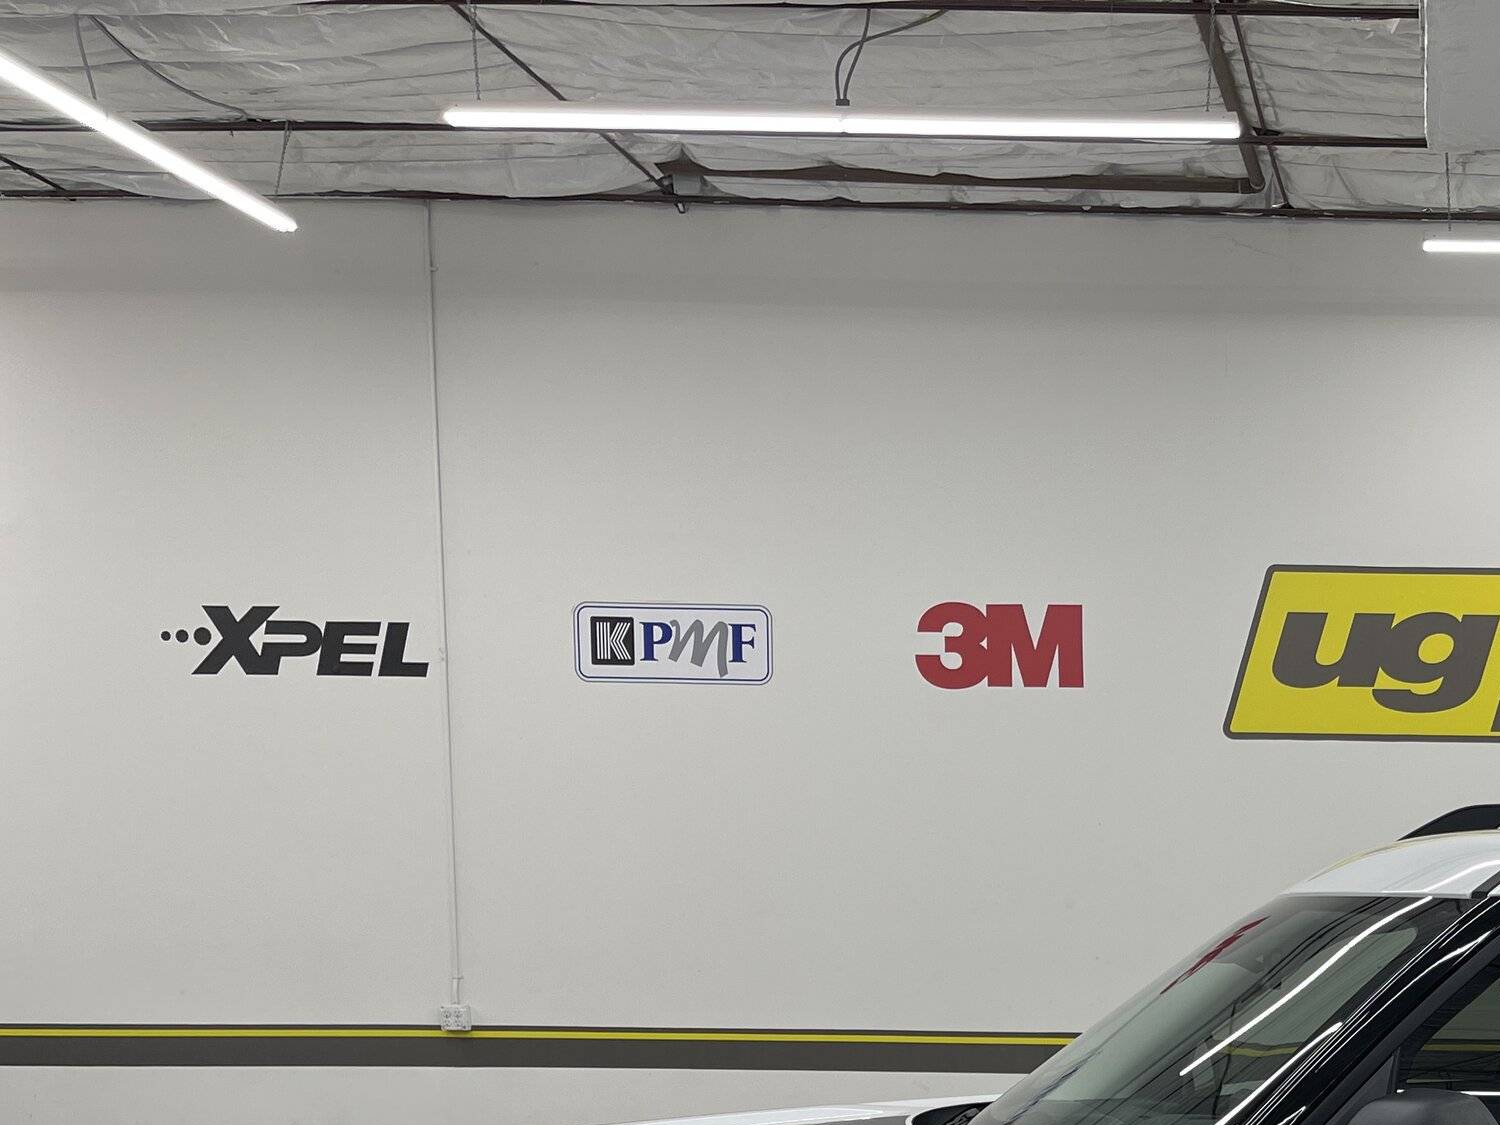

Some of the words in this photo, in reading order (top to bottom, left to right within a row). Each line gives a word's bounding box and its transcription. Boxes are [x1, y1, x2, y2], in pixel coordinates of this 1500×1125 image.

[191, 605, 430, 678] XPEL
[590, 616, 757, 678] KPMF
[915, 602, 1084, 690] 3M
[1272, 611, 1500, 713] ug
